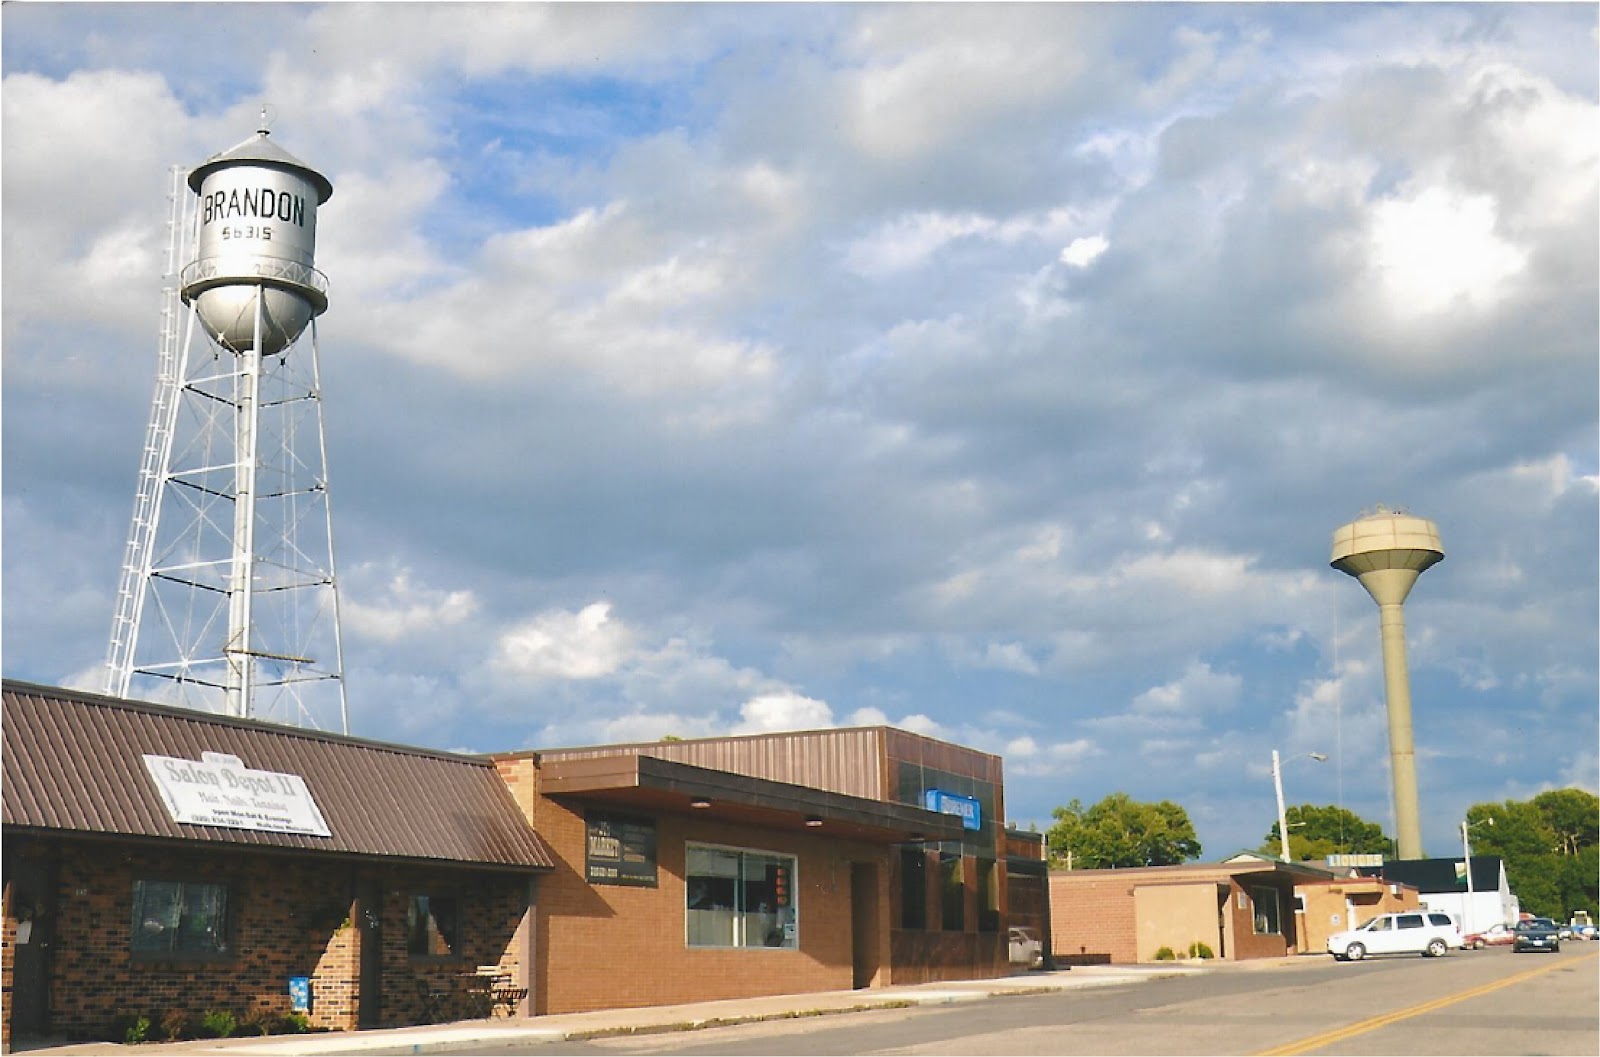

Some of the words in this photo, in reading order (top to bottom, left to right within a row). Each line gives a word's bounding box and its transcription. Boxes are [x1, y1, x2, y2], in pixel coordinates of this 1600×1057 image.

[203, 188, 305, 227] BRANDON
[222, 226, 272, 240] 56315
[163, 760, 220, 789] Salon
[221, 768, 277, 796] Depot
[276, 775, 297, 797] II
